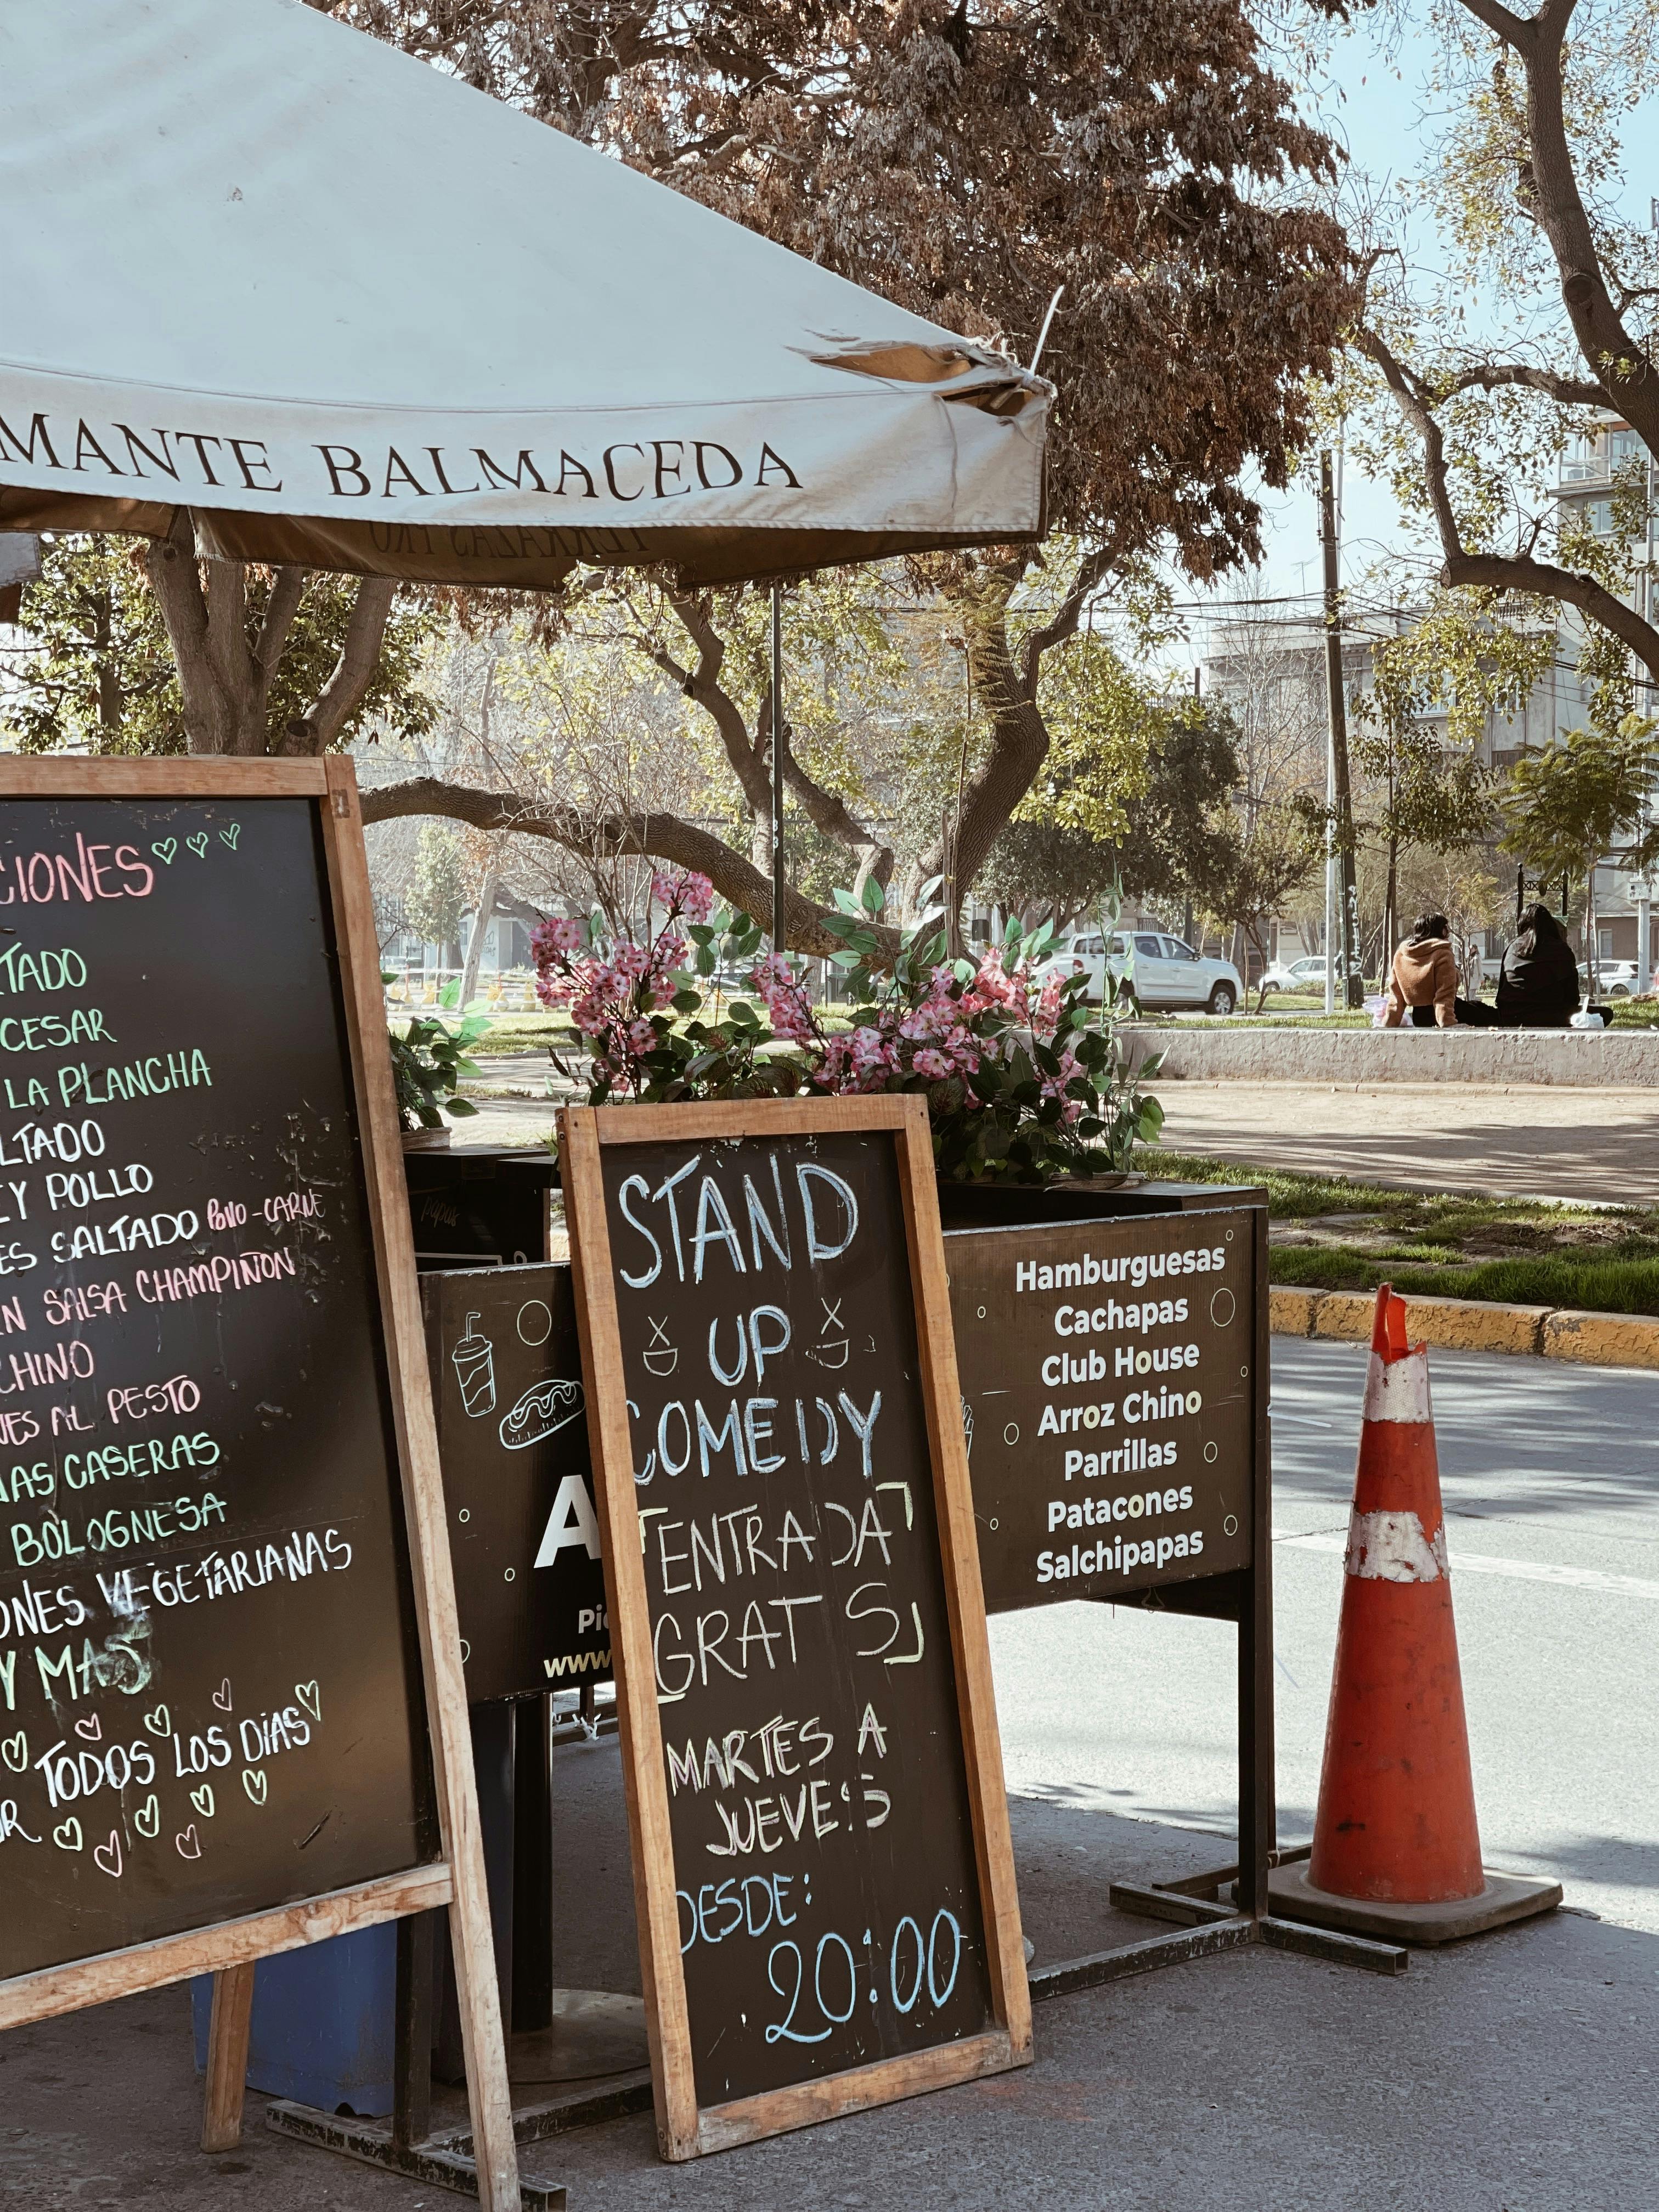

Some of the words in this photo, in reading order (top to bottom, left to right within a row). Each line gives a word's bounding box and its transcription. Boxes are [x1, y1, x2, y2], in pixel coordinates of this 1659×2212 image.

[0, 413, 283, 493] MANTE
[311, 441, 804, 501] BALMACEDA
[0, 942, 87, 995] TADO
[1, 1008, 117, 1052] CESAR
[4, 1078, 49, 1109] LA
[58, 1048, 212, 1108] PLANCHA
[46, 1164, 154, 1211] POLLO
[51, 1210, 199, 1263] SALTADO
[619, 1153, 859, 1289] STAND
[1015, 1246, 1225, 1293] Hamburguesas
[0, 1296, 26, 1335] N
[43, 1282, 127, 1325] SALSA
[1054, 1298, 1189, 1336] Cachapas
[708, 1305, 791, 1386] UP
[1042, 1349, 1107, 1386] Club
[1115, 1344, 1200, 1378] House
[52, 1406, 95, 1436] AL
[107, 1375, 200, 1424] PESTO
[1037, 1400, 1115, 1437] Arroz
[1122, 1386, 1201, 1424] Chino
[64, 1432, 219, 1489] CASERAS
[1065, 1439, 1177, 1481] Parrillas
[10, 1492, 227, 1567] BOLOGNESA
[1048, 1486, 1193, 1532] Patacones
[95, 1528, 352, 1614] VEGETARIANAS
[658, 1498, 893, 1595] ENTRADA
[1036, 1530, 1204, 1583] Salchipapas
[34, 1740, 155, 1807] TODOS
[173, 1725, 232, 1778] LOS
[667, 1714, 834, 1797] MARTES
[858, 1703, 888, 1759] A
[765, 1908, 961, 2044] 20:00
